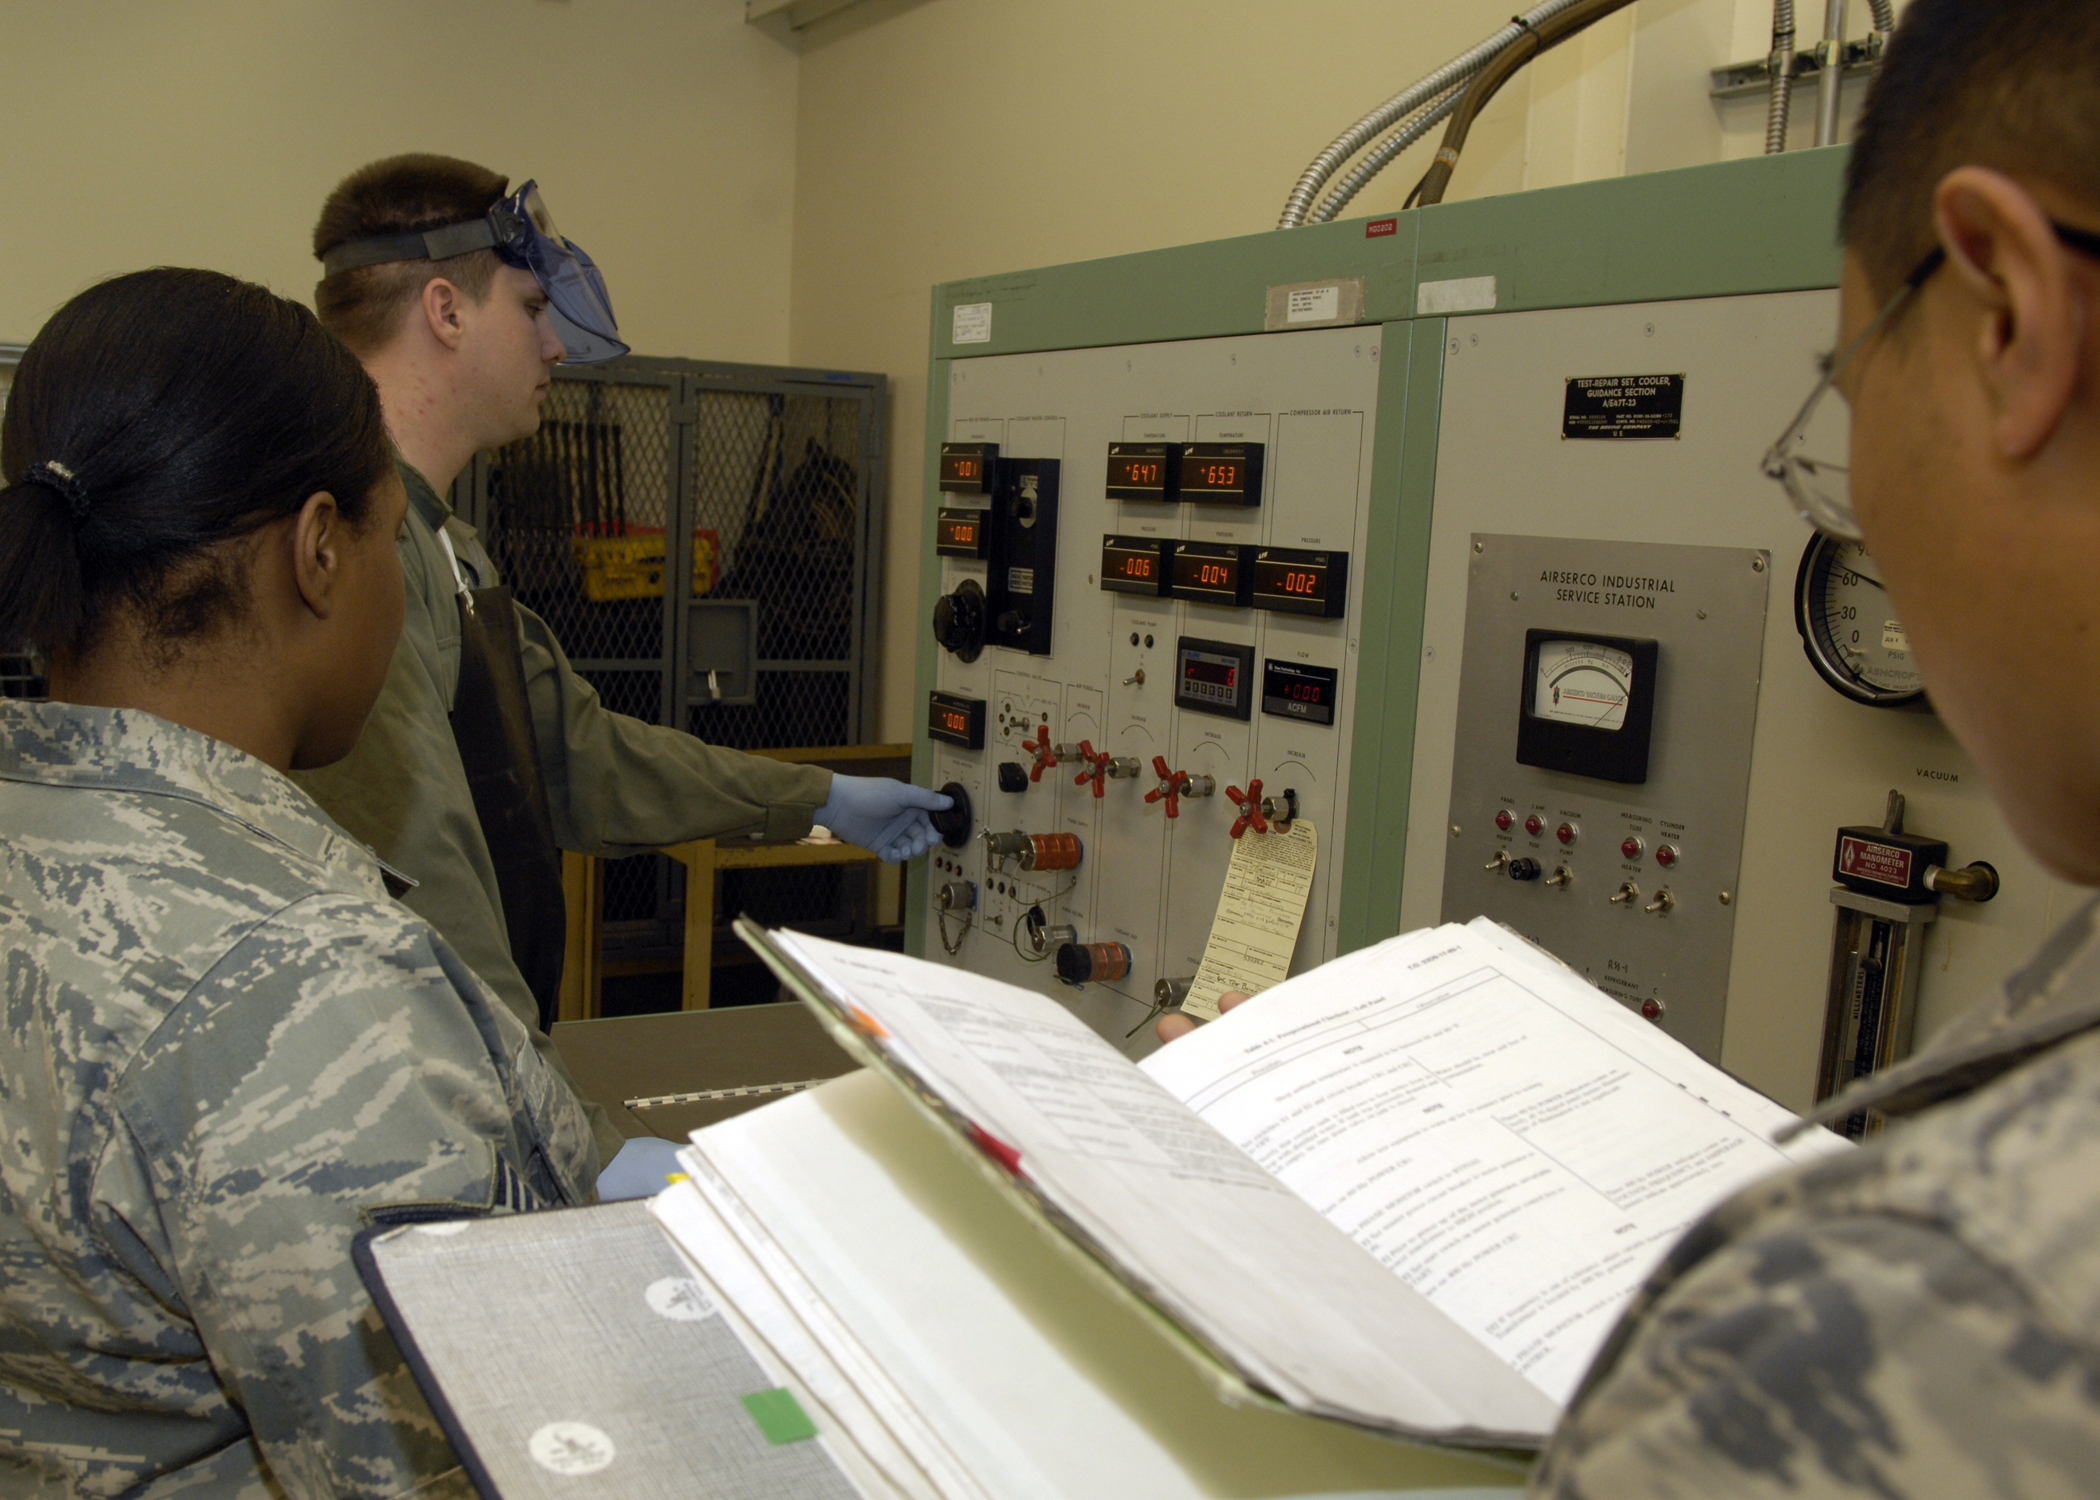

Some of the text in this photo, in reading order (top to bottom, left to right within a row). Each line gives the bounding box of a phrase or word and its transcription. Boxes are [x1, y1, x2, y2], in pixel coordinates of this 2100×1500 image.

[1577, 376, 1671, 388] TEST-REPAIR SET, COOLER,
[1587, 388, 1656, 398] GUIDANCE SECTION
[1540, 570, 1675, 592] AIRSERCO INDUSTRIAL
[1842, 572, 1858, 586] 60
[1556, 588, 1655, 609] SERVICE STATION
[1841, 606, 1856, 620] 30
[1852, 630, 1860, 643] 0
[1888, 651, 1905, 660] PSIG
[1287, 703, 1307, 714] ACFM
[1287, 750, 1306, 758] INCREASE
[1916, 768, 1959, 782] VACUUM
[1500, 797, 1515, 805] PANEL
[1559, 810, 1582, 819] VACUUM
[1620, 812, 1653, 824] MEASURING
[1629, 824, 1642, 832] TUBE
[1660, 820, 1685, 831] CYLINDER
[1497, 834, 1513, 842] POWER
[1660, 831, 1680, 840] HEATER
[1866, 845, 1900, 859] AIRSERCO
[1860, 852, 1905, 869] MANOMETER
[1621, 864, 1641, 873] HEATER
[1865, 862, 1897, 874] NO. 4023
[1604, 975, 1639, 990] REFRIGERANT
[1598, 985, 1642, 1004] MEASURING TUBE
[1853, 970, 1864, 1019] MILLIMETERS
